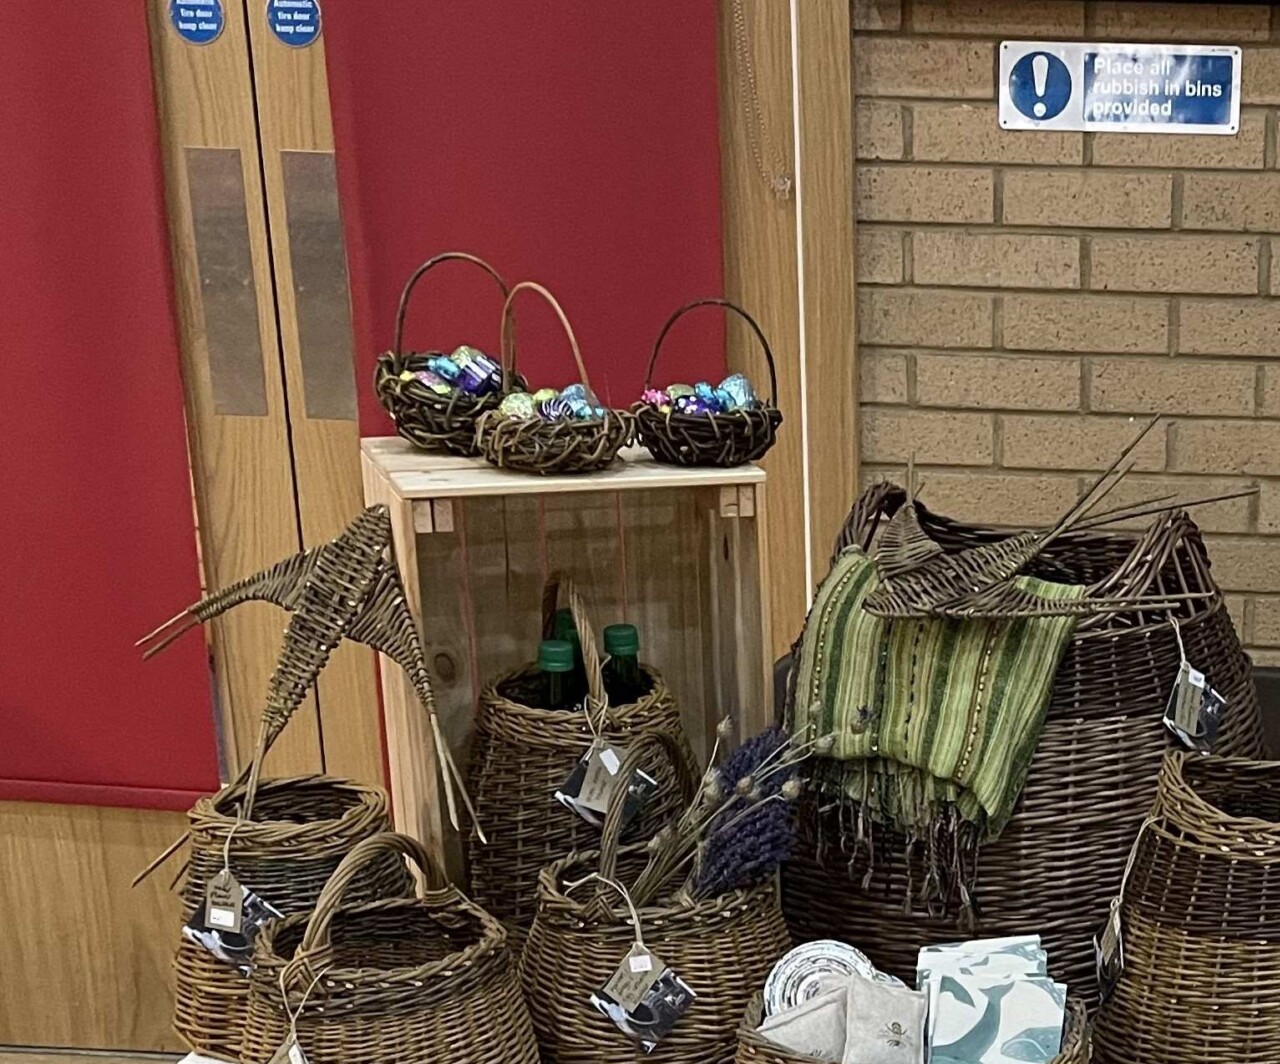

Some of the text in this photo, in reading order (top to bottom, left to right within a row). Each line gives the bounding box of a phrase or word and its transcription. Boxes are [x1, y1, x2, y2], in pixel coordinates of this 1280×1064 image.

[1093, 58, 1170, 76] Place all
[1093, 79, 1222, 97] rubbish in bins
[1092, 99, 1172, 117] provided
